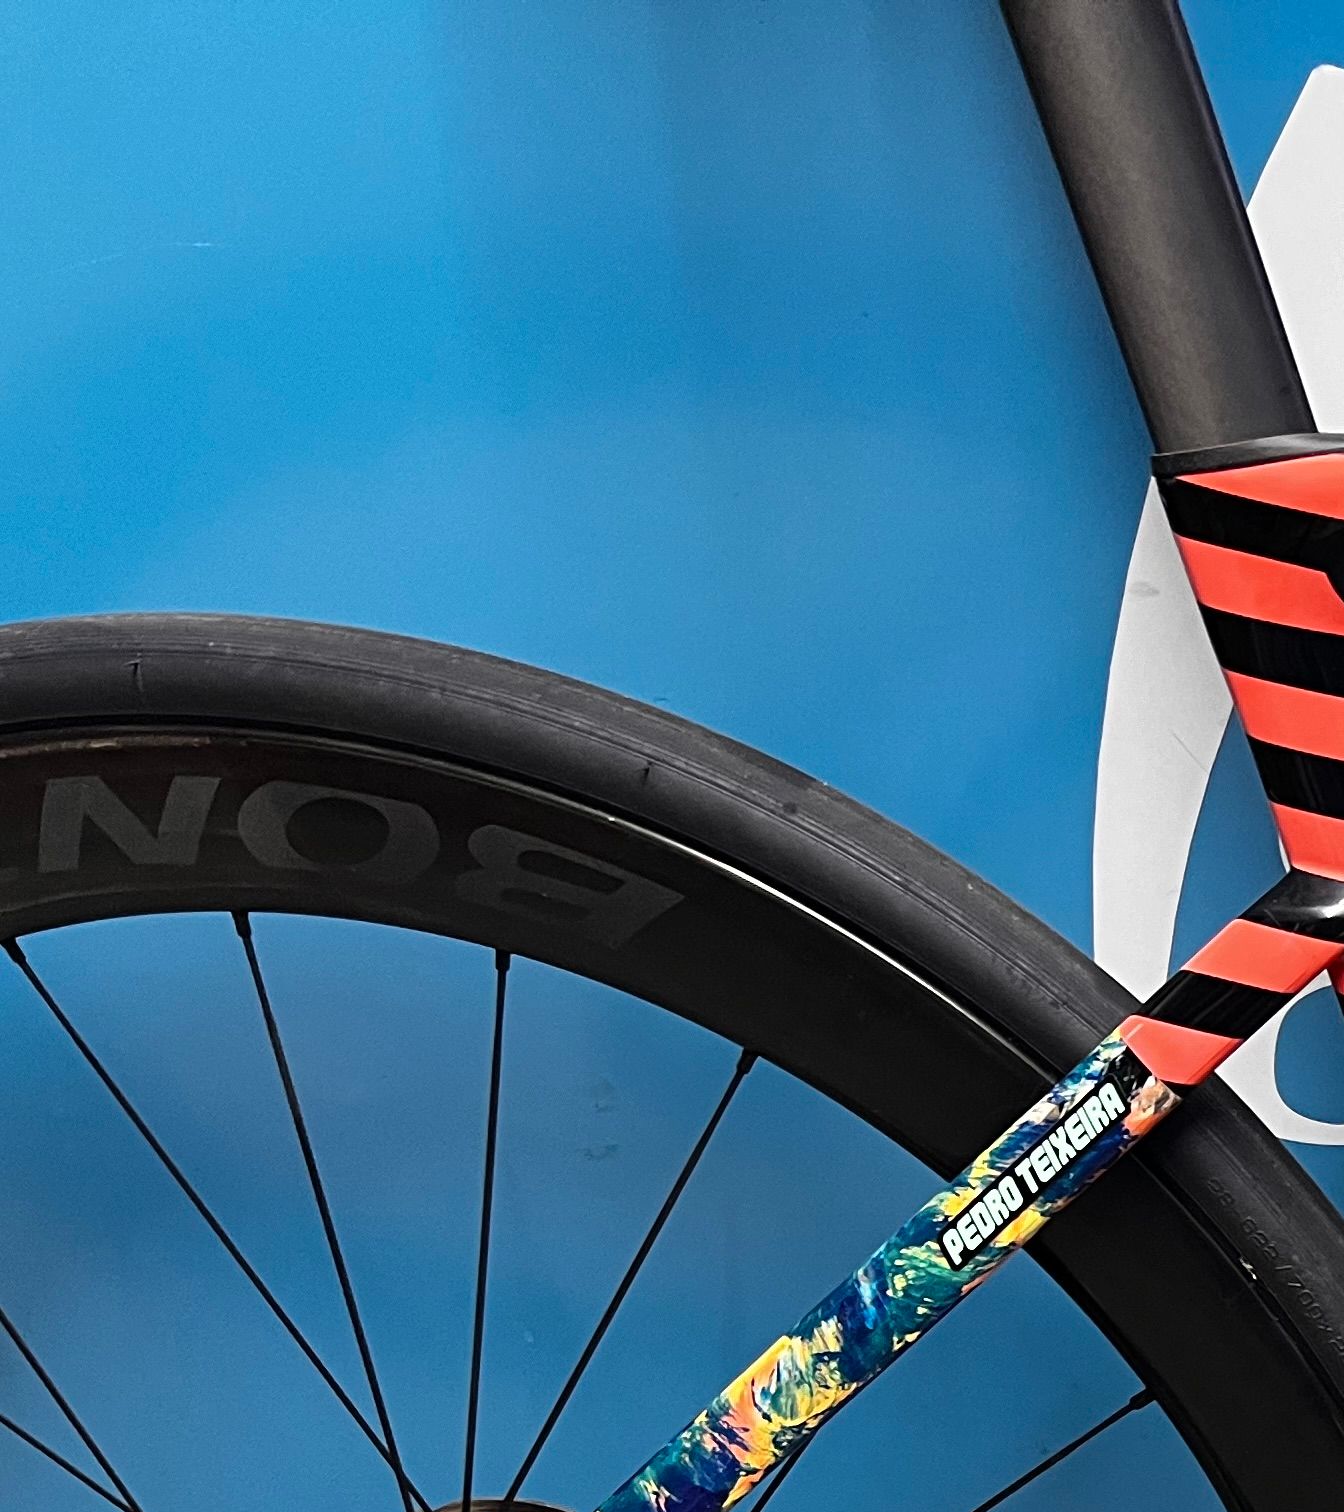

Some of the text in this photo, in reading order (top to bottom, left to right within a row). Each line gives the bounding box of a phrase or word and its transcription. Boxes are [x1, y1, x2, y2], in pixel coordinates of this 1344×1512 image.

[0, 775, 686, 951] BON
[942, 1082, 1126, 1267] PEDRO TEIXEIRA
